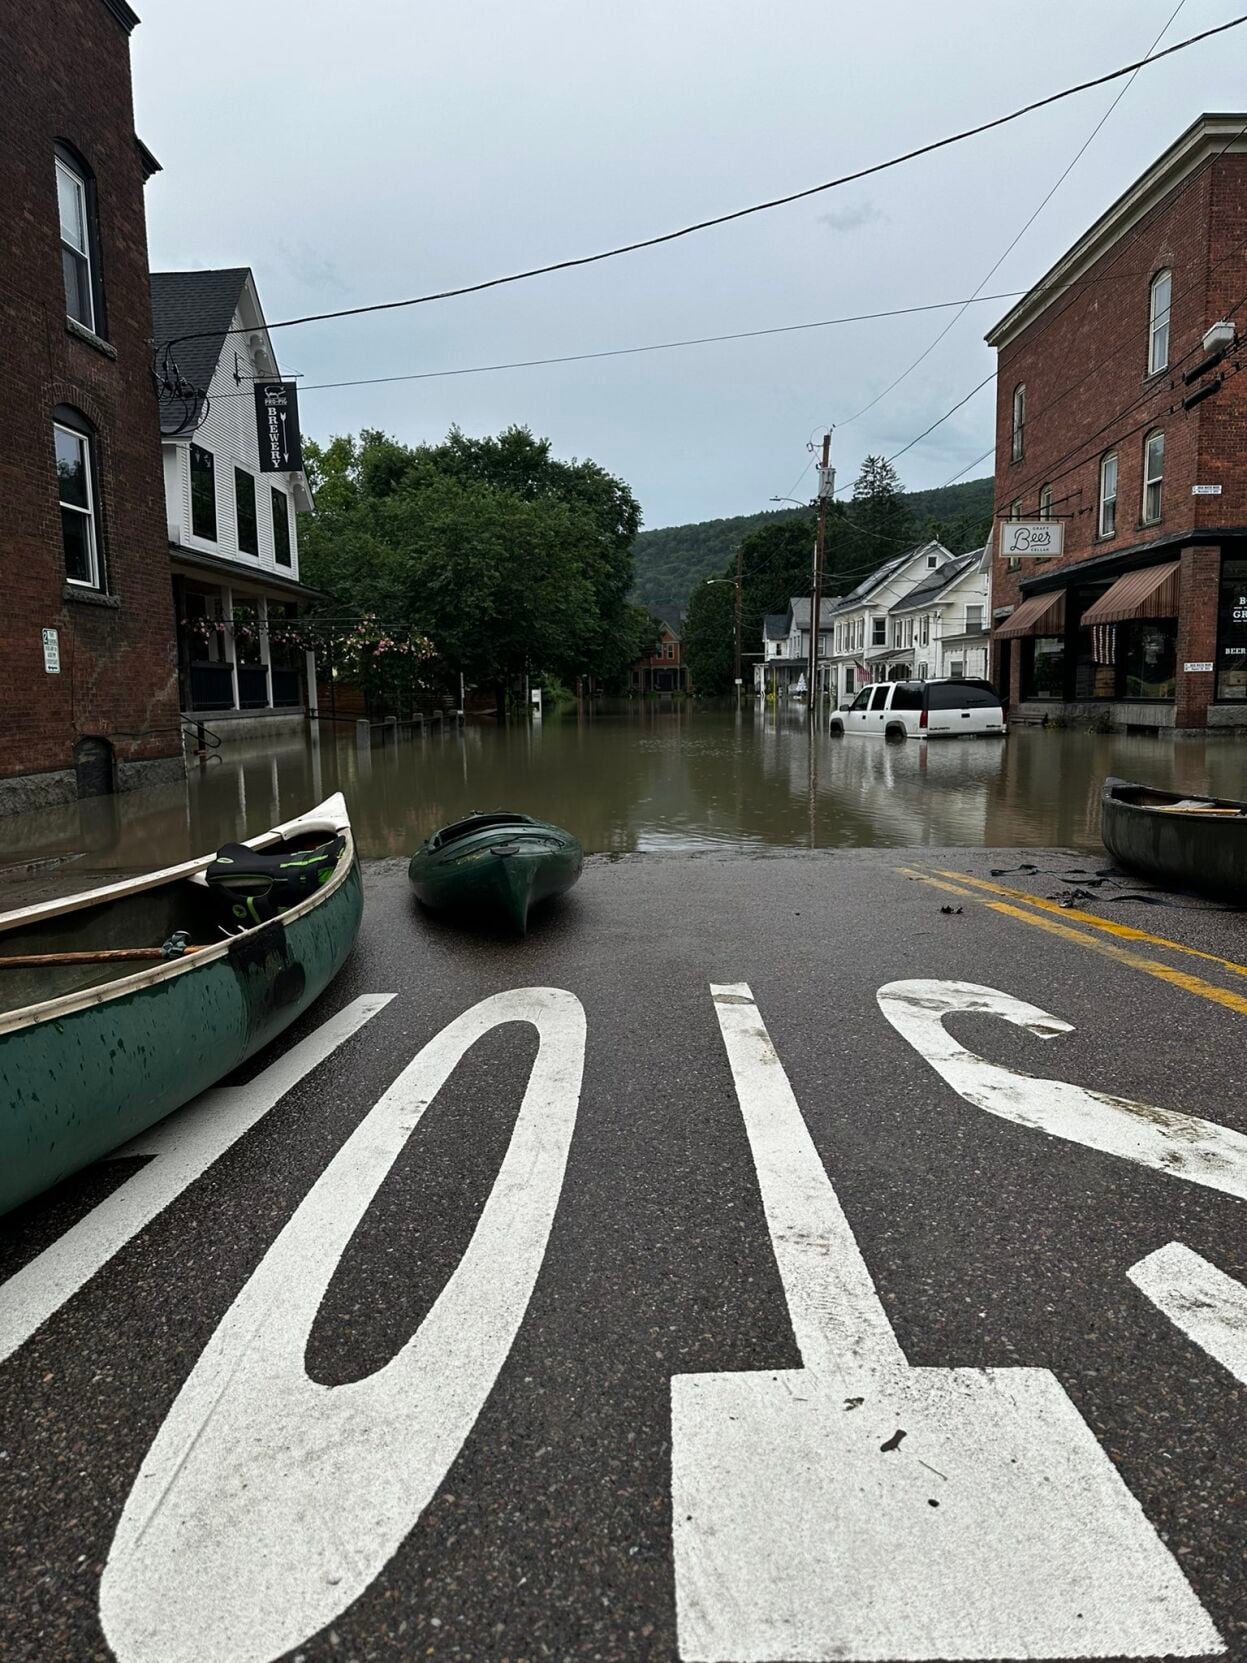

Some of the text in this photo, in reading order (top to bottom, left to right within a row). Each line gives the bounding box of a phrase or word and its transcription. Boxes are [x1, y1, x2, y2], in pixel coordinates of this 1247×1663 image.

[267, 407, 280, 468] BREWERY
[1010, 528, 1051, 551] Beer
[1239, 596, 1247, 605] B
